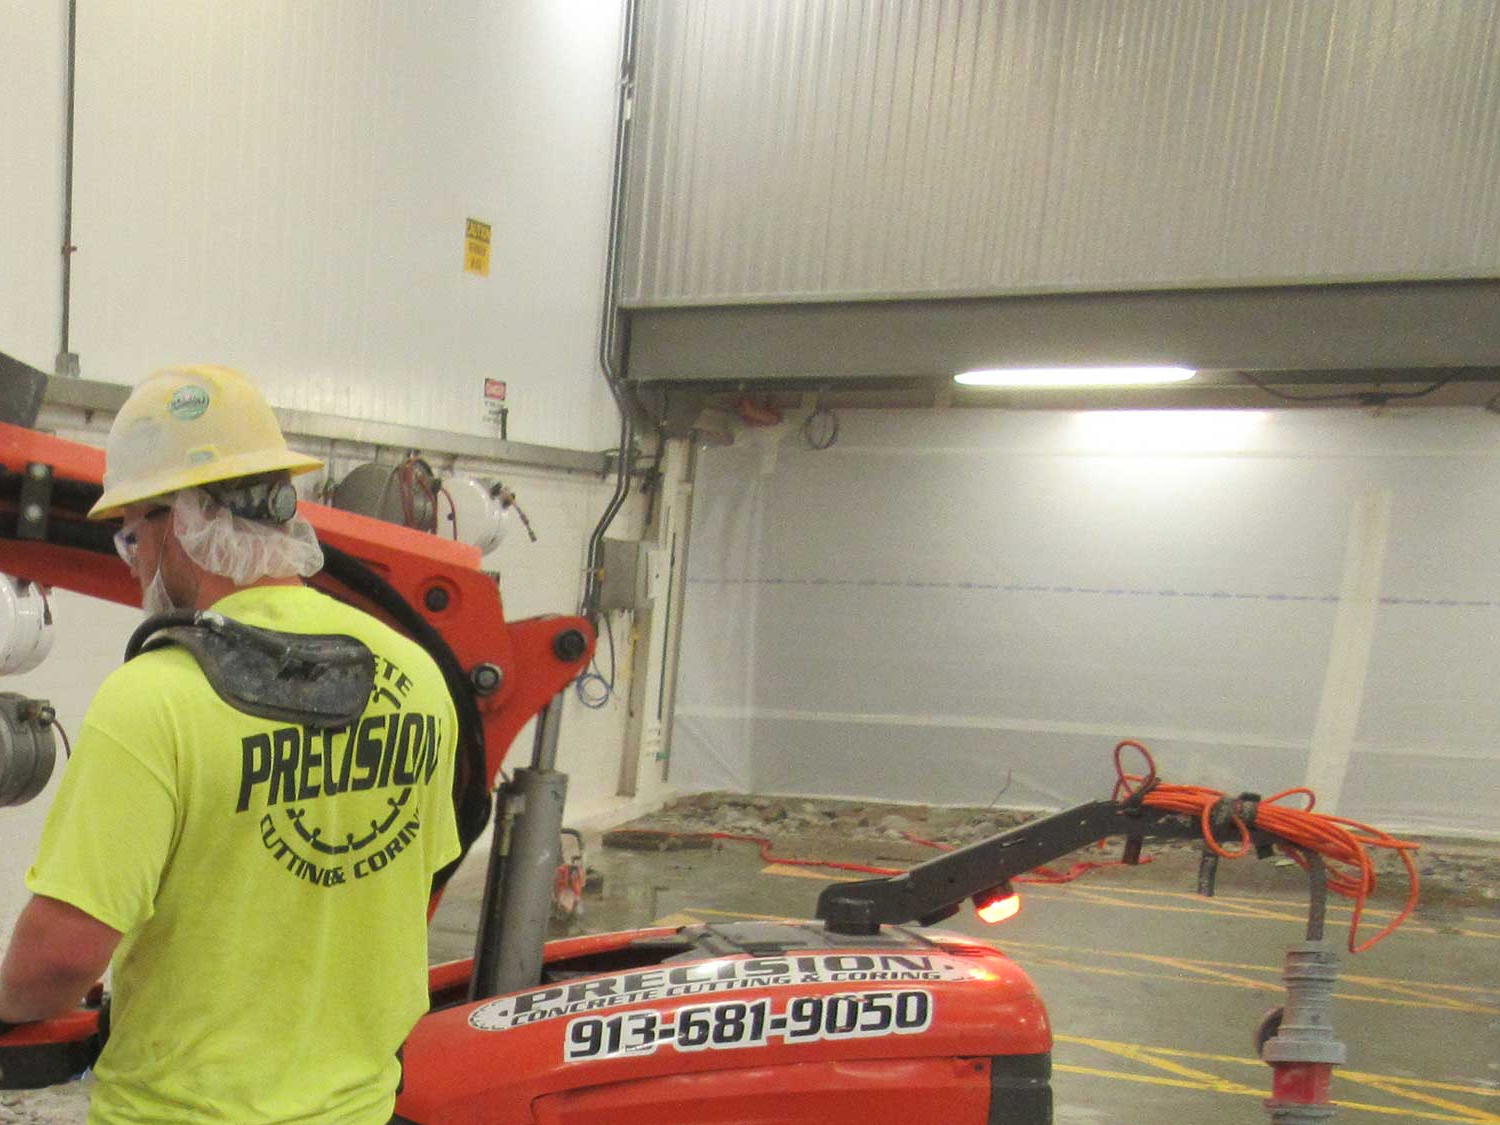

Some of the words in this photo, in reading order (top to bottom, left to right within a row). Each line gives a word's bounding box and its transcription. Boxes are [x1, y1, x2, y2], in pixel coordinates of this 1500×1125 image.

[235, 712, 442, 814] PRECISION
[353, 807, 421, 879] CORIN
[510, 986, 659, 1026] CONCRETE
[666, 976, 792, 997] CUTTING
[801, 972, 821, 983] &
[831, 971, 942, 982] CORING
[513, 955, 933, 1014] PRECISION
[570, 991, 929, 1058] 913-681-9050
